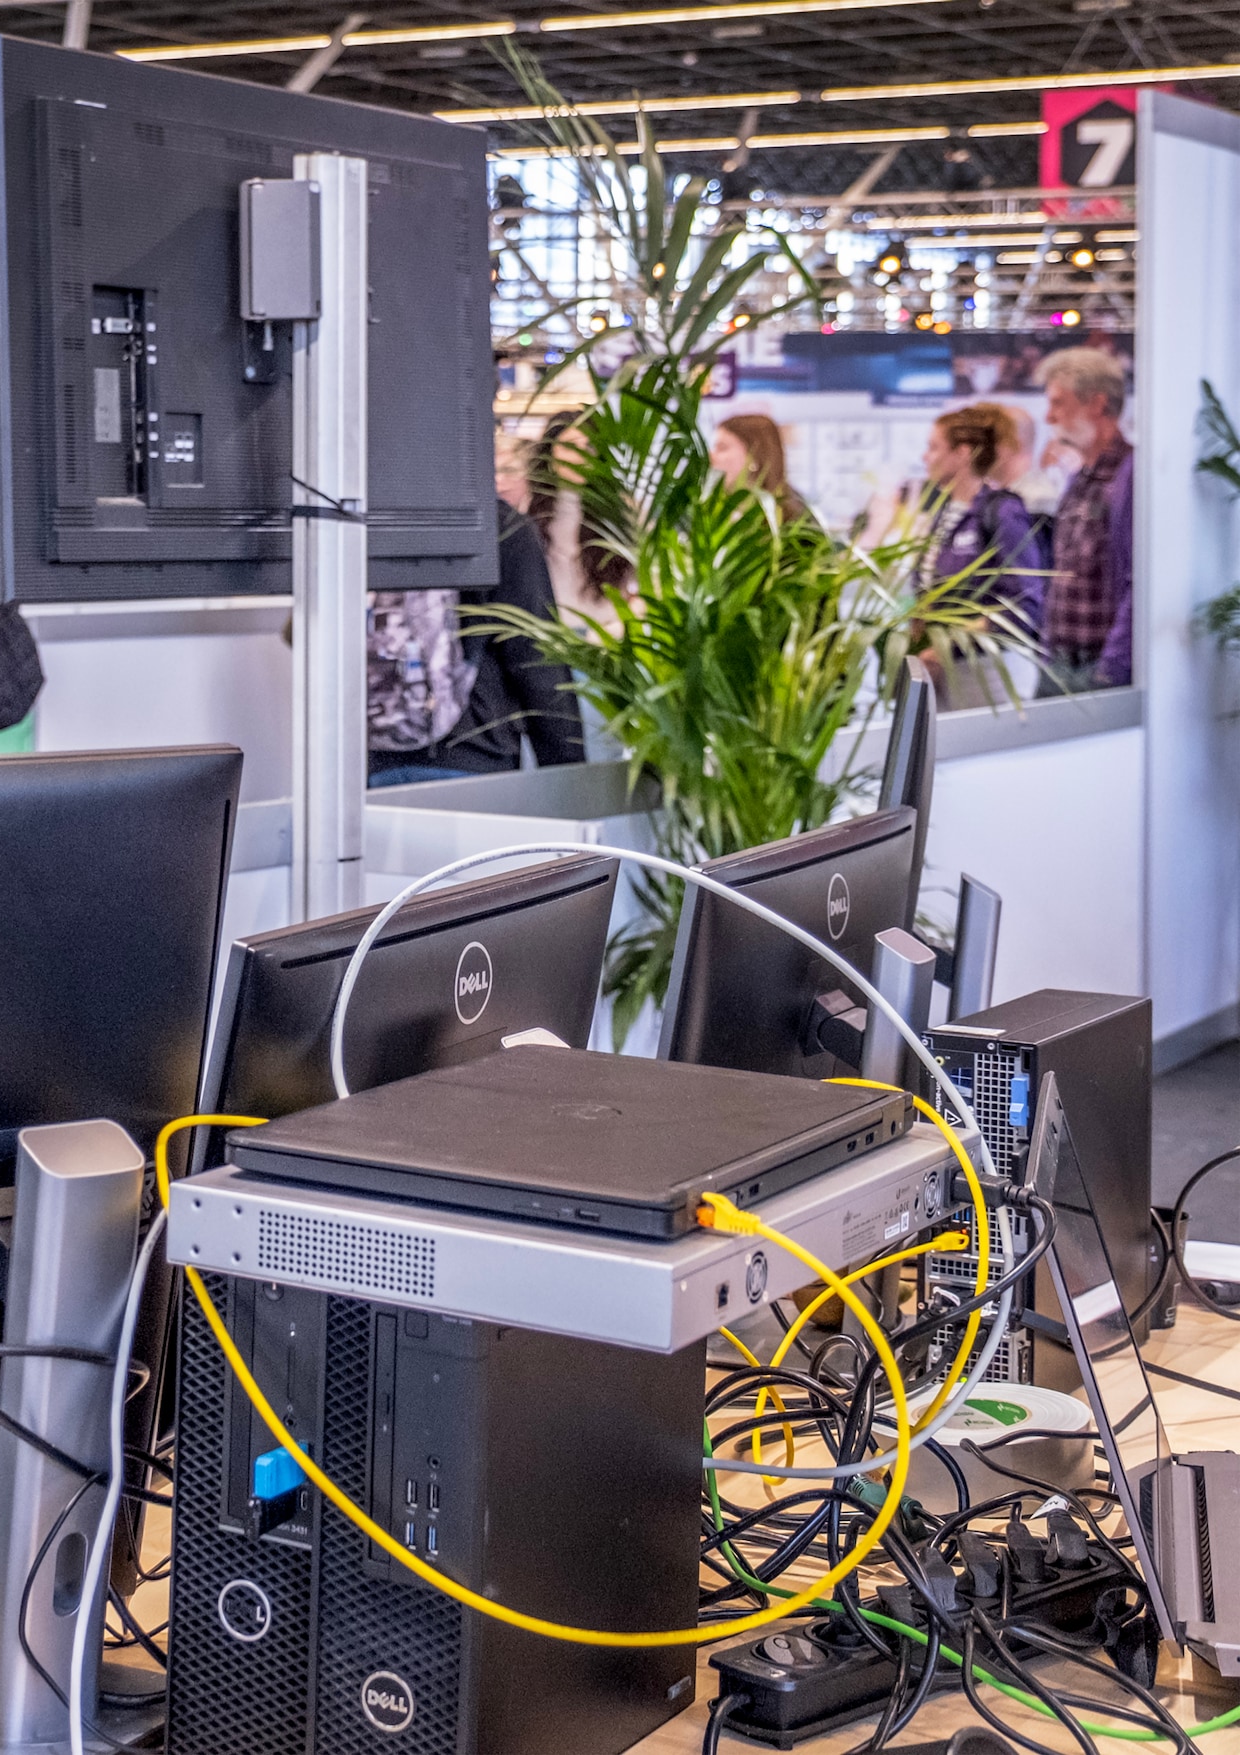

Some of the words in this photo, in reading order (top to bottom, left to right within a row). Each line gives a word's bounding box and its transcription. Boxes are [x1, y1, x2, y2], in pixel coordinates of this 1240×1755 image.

[1076, 119, 1134, 188] 7
[830, 896, 848, 916] DELL
[458, 970, 489, 997] DELL
[367, 1688, 408, 1714] DELL
